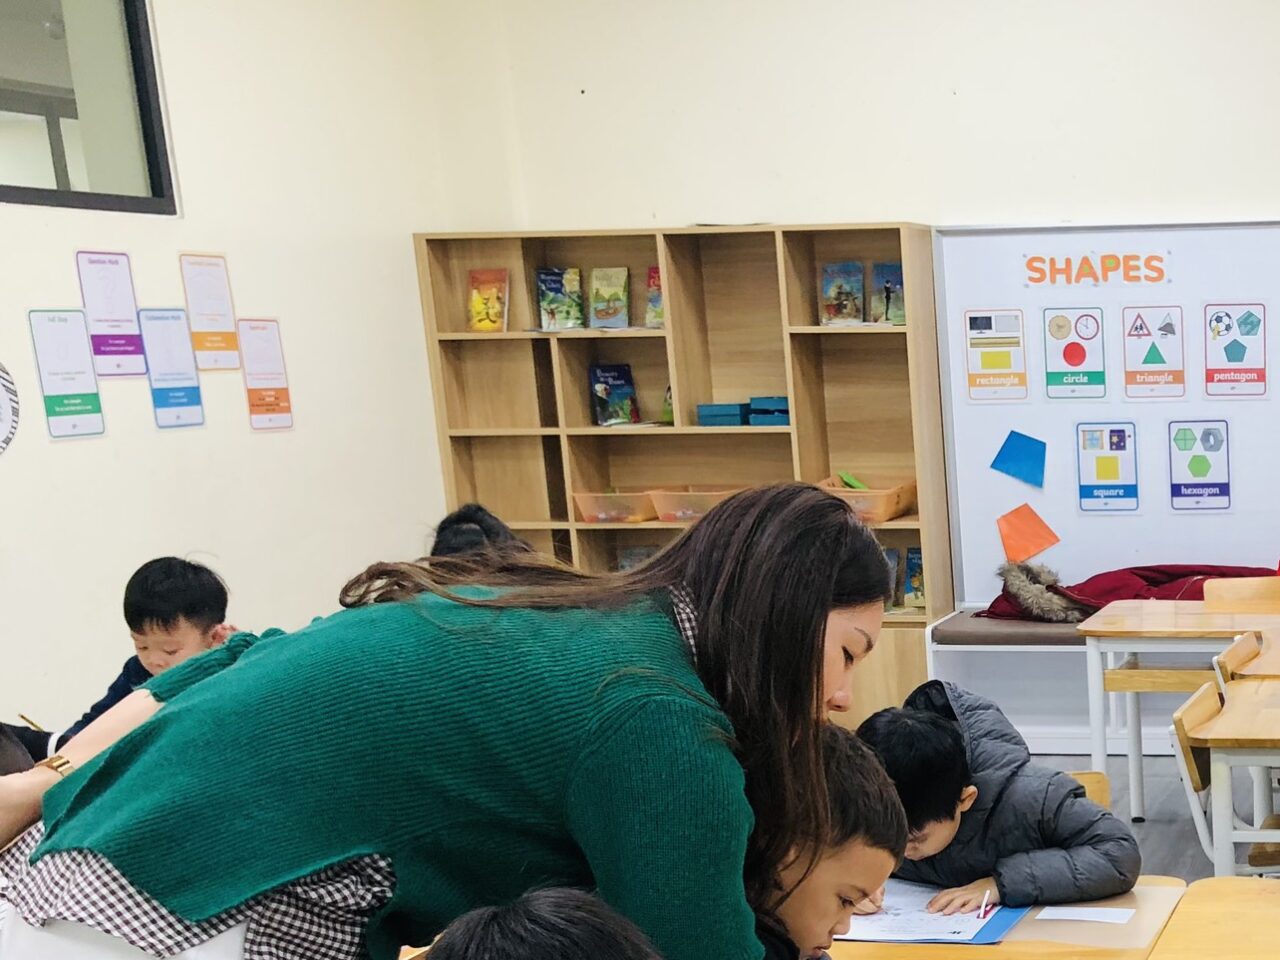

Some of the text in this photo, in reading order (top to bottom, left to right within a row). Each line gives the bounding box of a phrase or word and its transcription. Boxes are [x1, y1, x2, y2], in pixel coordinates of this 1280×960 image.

[1025, 254, 1165, 284] SHAPES
[976, 374, 1019, 387] rectangle
[1063, 373, 1088, 384] circle
[1136, 373, 1173, 384] triangle
[1213, 371, 1258, 382] pentagon
[1093, 488, 1124, 498] square
[1181, 485, 1220, 497] hexagon
